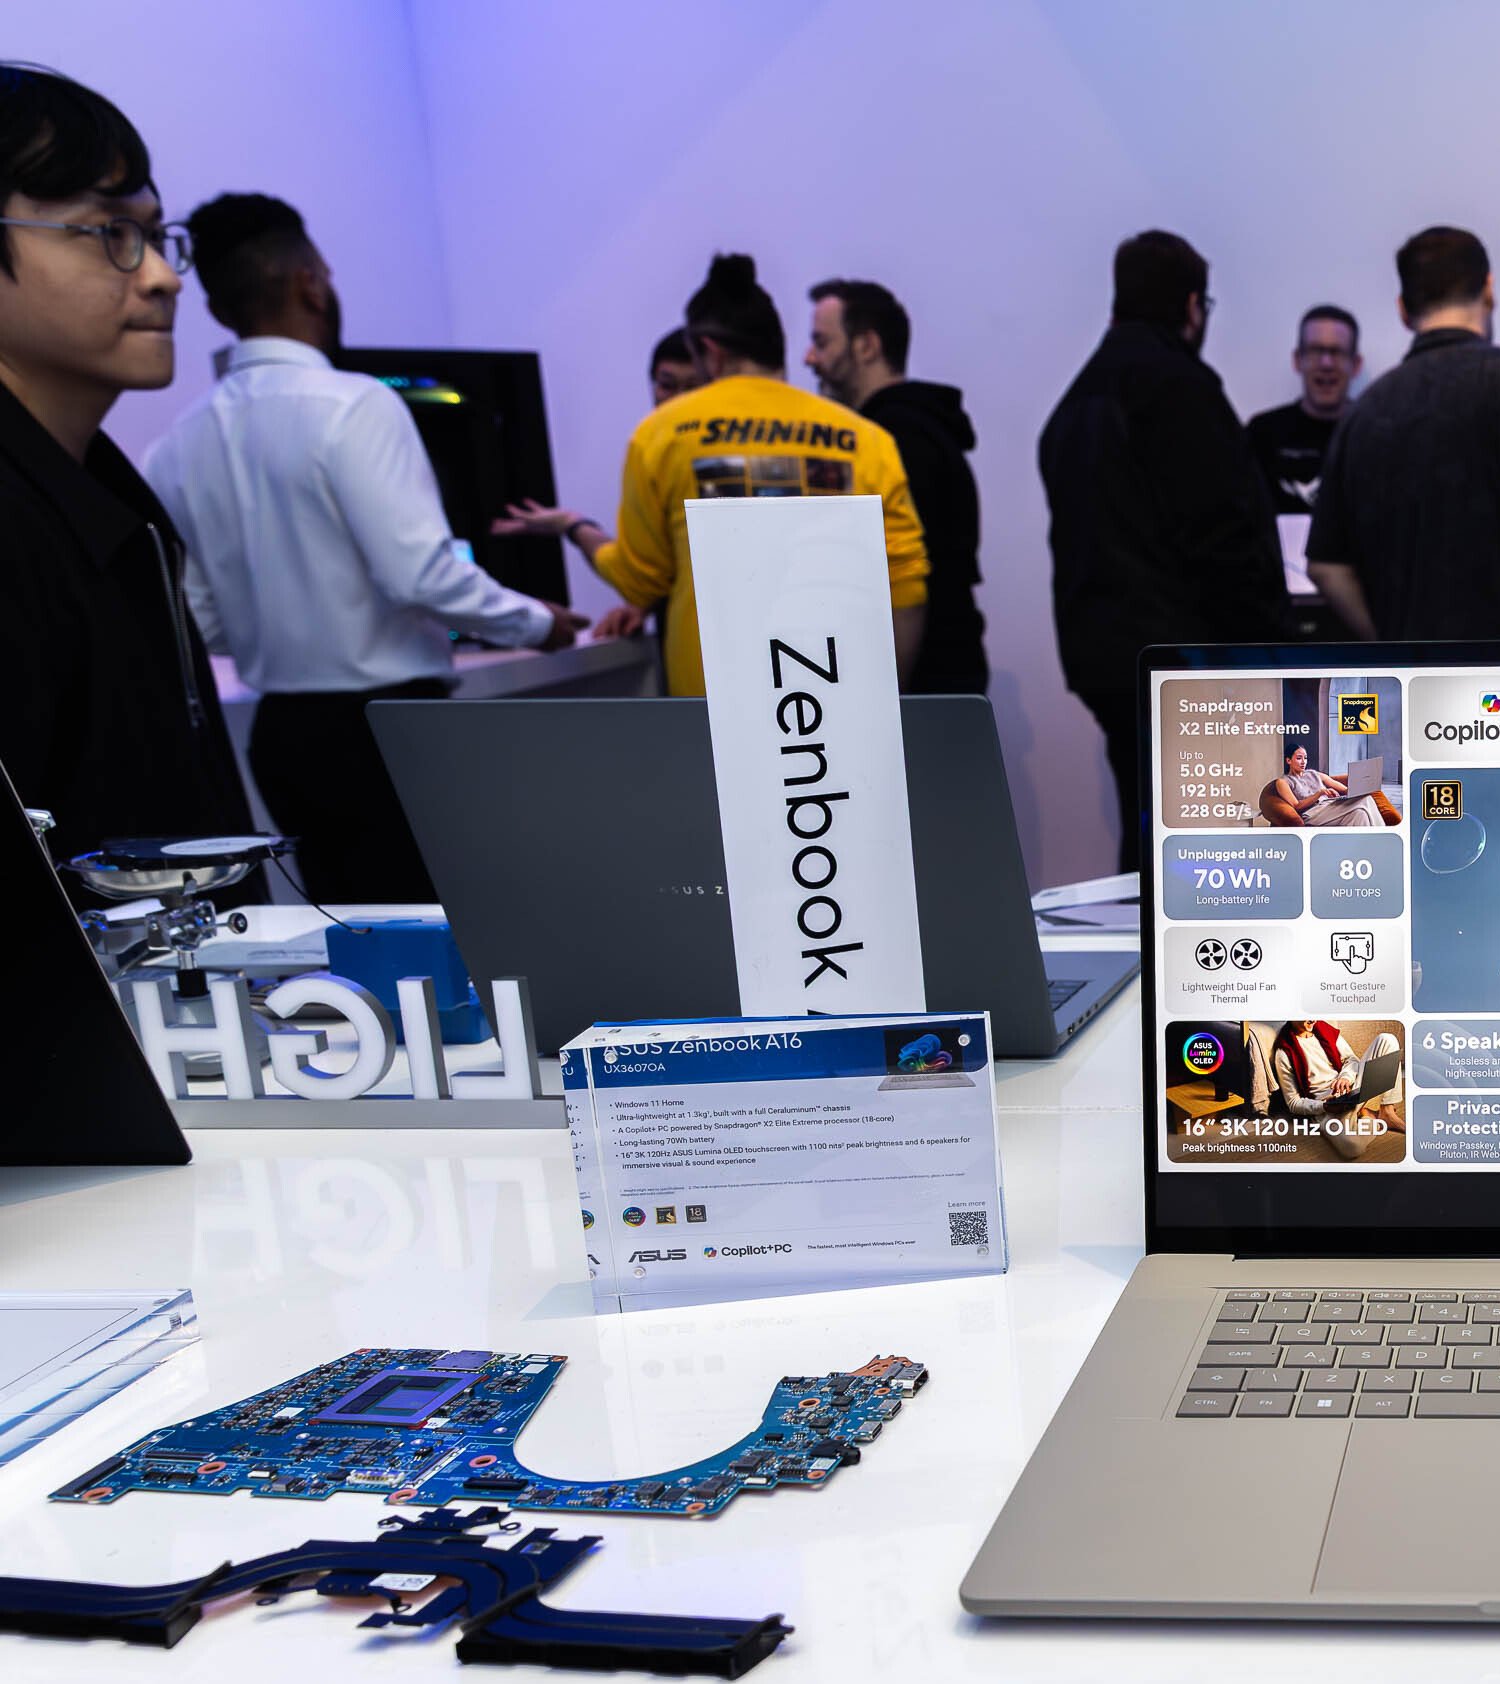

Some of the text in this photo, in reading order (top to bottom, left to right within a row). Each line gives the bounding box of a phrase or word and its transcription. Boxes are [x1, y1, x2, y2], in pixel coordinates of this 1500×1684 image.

[1179, 699, 1273, 715] Snapdragon
[1179, 722, 1310, 735] X2 Elite Extreme
[1179, 751, 1193, 761] Up
[1180, 764, 1243, 777] 5.0 GHz
[1180, 784, 1231, 797] 192 bit
[1430, 787, 1453, 806] 18
[769, 637, 864, 989] Zenbook
[1180, 804, 1251, 820] 228 GB/s
[1429, 807, 1455, 815] CORE
[1178, 849, 1287, 861] Unplugged all day
[1339, 860, 1373, 880] 80
[1194, 868, 1271, 889] 70 Wh
[1332, 888, 1381, 897] NPU TOPS
[1196, 895, 1270, 906] Long-battery life
[1182, 983, 1276, 992] Lightweight Dual Fan
[1320, 982, 1386, 991] Smart Gesture
[1211, 995, 1248, 1003] Thermal
[1330, 994, 1376, 1004] Touchpad
[669, 1033, 802, 1054] Zenbook A16
[1422, 1032, 1435, 1049] 6
[1193, 1057, 1213, 1065] OLED
[1449, 1056, 1490, 1066] Lossless
[616, 1113, 676, 1121] Ultra-lightweight
[1220, 1118, 1249, 1136] 3K
[1253, 1118, 1289, 1136] 120
[1293, 1119, 1321, 1136] Hz
[1326, 1118, 1388, 1136] OLED
[689, 1136, 715, 1144] battery
[1182, 1143, 1297, 1154] Peak brightness 1100nits
[1420, 1141, 1457, 1150] Windows
[1460, 1141, 1496, 1152] Passkey,
[628, 1249, 687, 1263] ASUS
